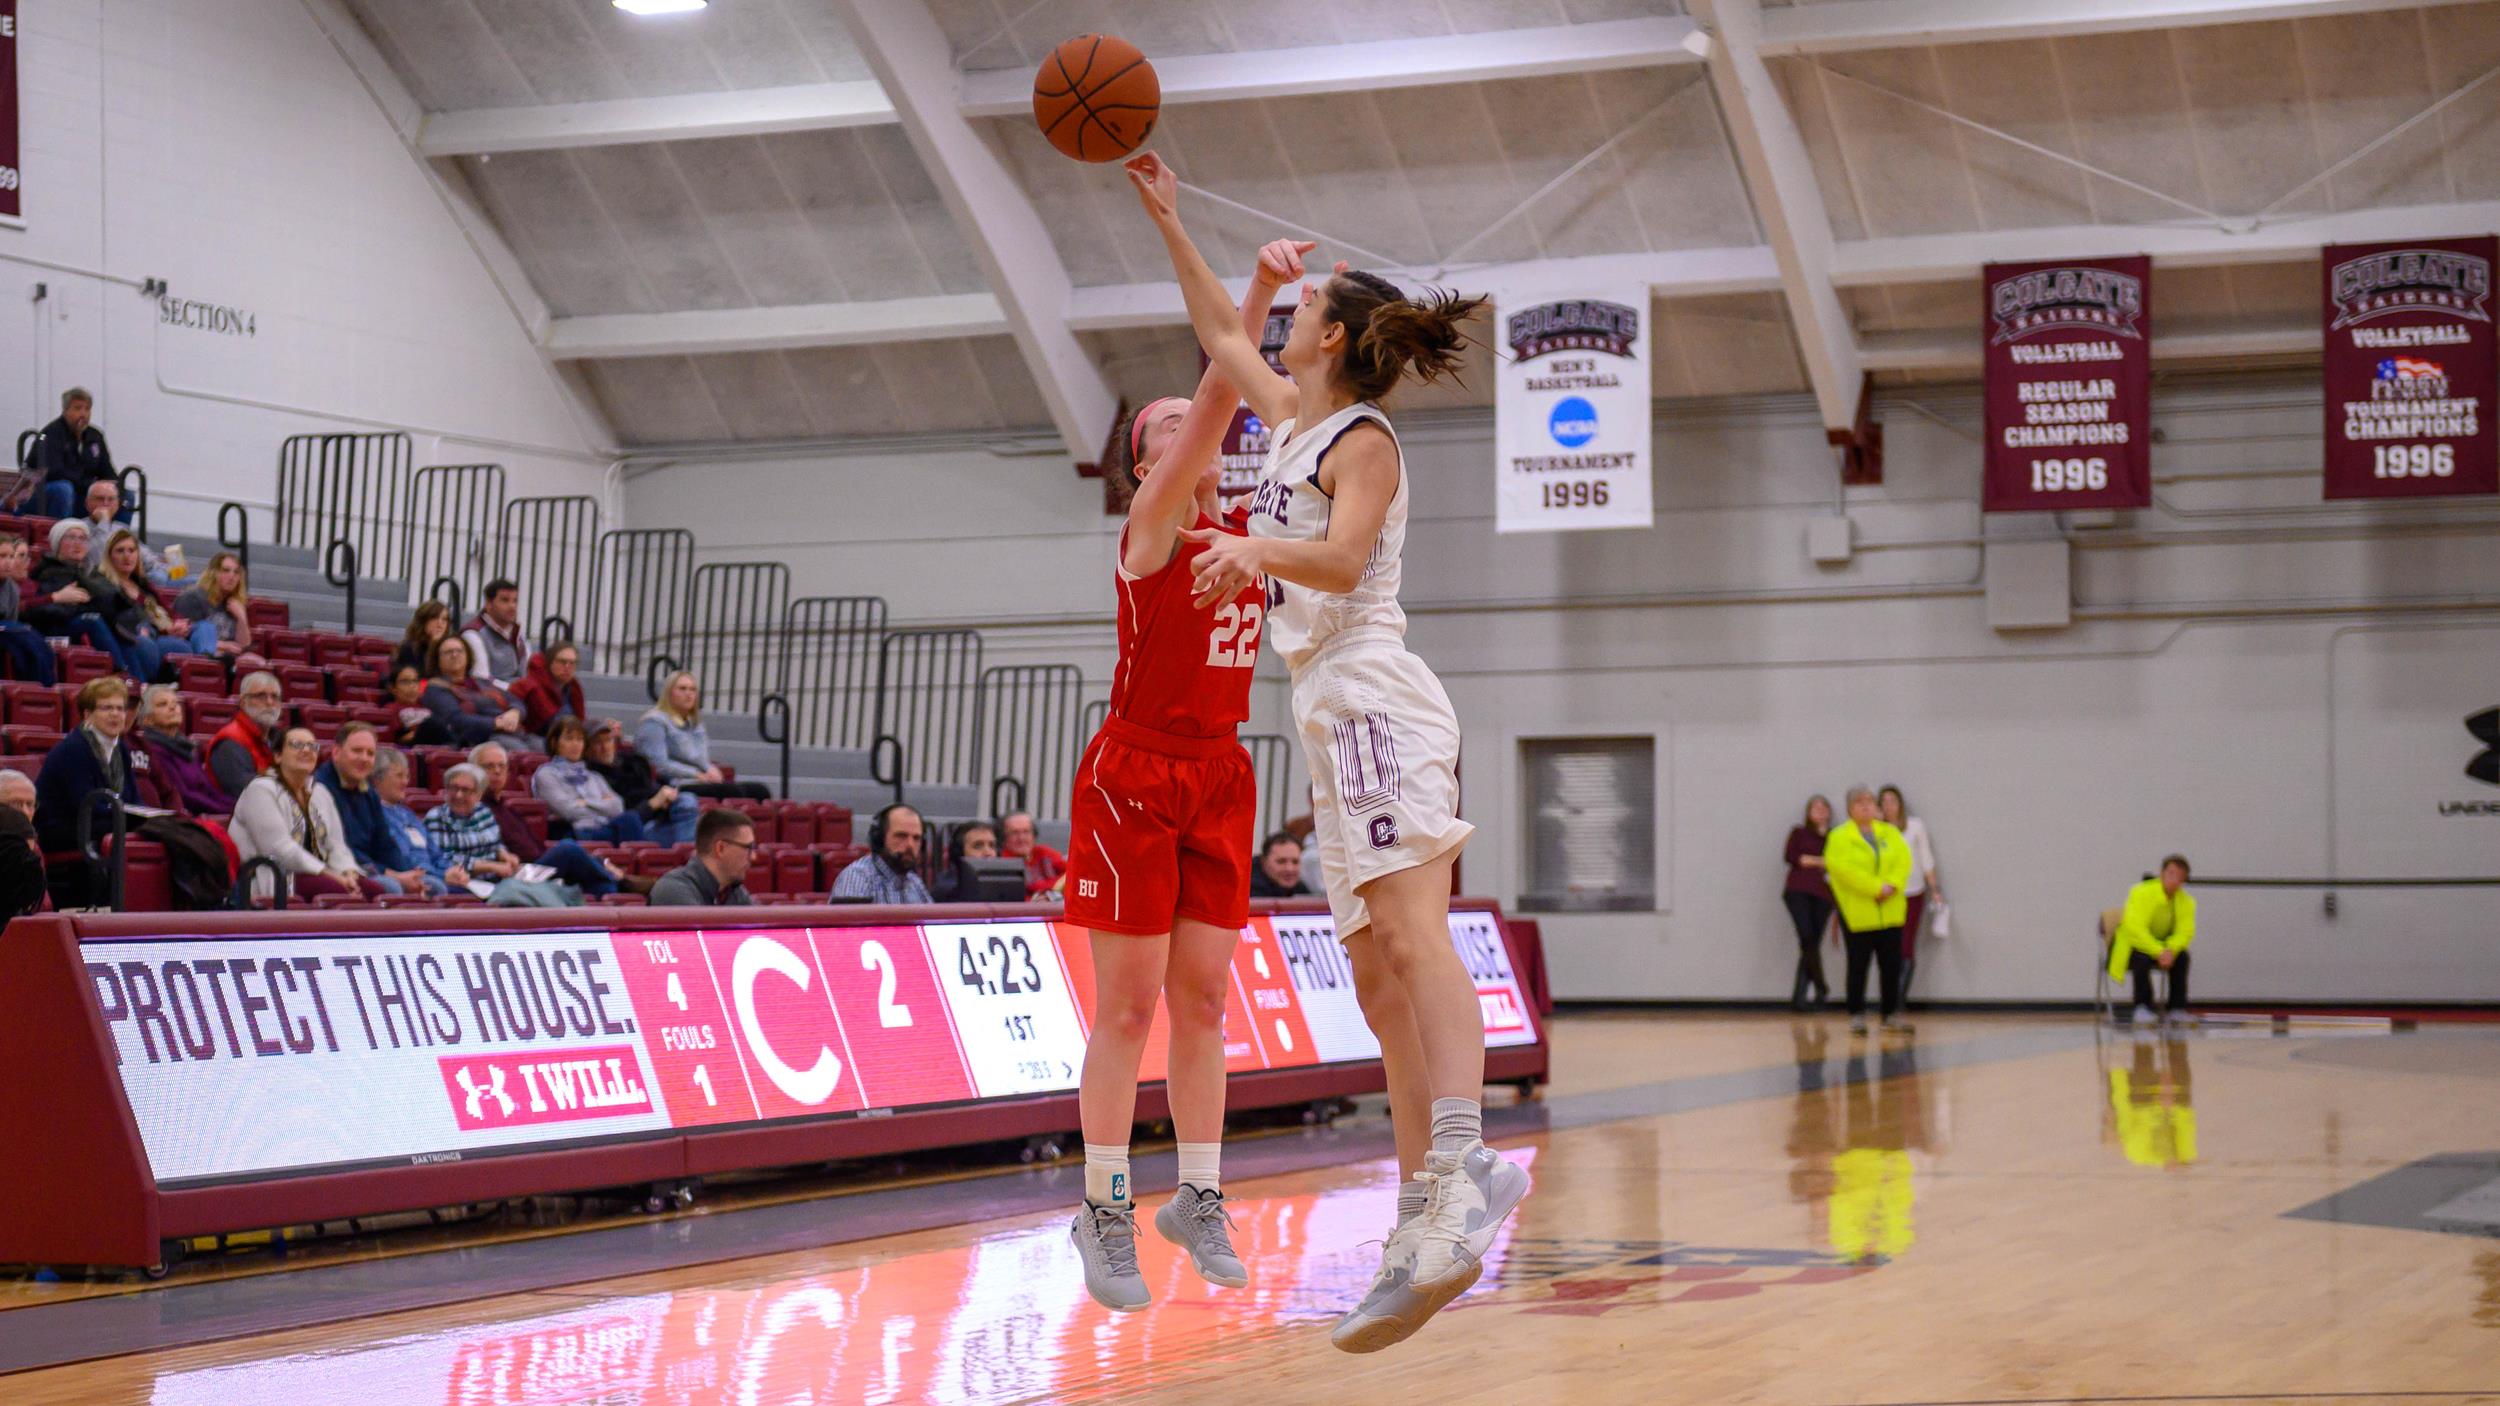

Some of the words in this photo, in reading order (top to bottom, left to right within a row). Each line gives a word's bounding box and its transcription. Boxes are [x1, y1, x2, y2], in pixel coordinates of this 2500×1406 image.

[2336, 252, 2488, 302] COLGATE
[1997, 270, 2138, 318] COLGATE
[160, 296, 243, 336] SECTION
[247, 311, 256, 338] 4
[1509, 301, 1637, 344] COLGATE
[2351, 324, 2472, 348] VOLLEYBALL
[2010, 341, 2124, 364] VOLLEYBALL
[1551, 358, 1596, 375] MEN'S
[1525, 375, 1622, 393] BASKETBALL
[2018, 379, 2116, 402] REGULAR
[2025, 401, 2109, 424] SEASON
[2343, 398, 2480, 419] TOURNAMENT
[2004, 423, 2129, 447] CHAMPIONS
[2344, 416, 2480, 440] CHAMPIONS
[1512, 453, 1636, 473] TOURNAMENT
[2031, 457, 2108, 491] 1996
[2374, 444, 2455, 478] 1996
[1542, 481, 1610, 508] 1996
[1206, 603, 1263, 668] 22
[1079, 879, 1099, 898] BU
[643, 940, 679, 965] TOL
[958, 935, 1042, 996] 4:23
[1279, 929, 1350, 990] PROT
[666, 972, 688, 1011] 4
[860, 940, 914, 1028] 2
[88, 956, 341, 1066] PROTECT
[332, 949, 463, 1051] THIS
[462, 948, 637, 1043] HOUSE.
[731, 935, 842, 1105] C
[661, 1024, 717, 1051] FOULS
[1004, 1014, 1035, 1041] 1ST
[1274, 1018, 1294, 1053] 0
[693, 1064, 717, 1107] 1
[411, 1151, 463, 1166] DAKTRONICS
